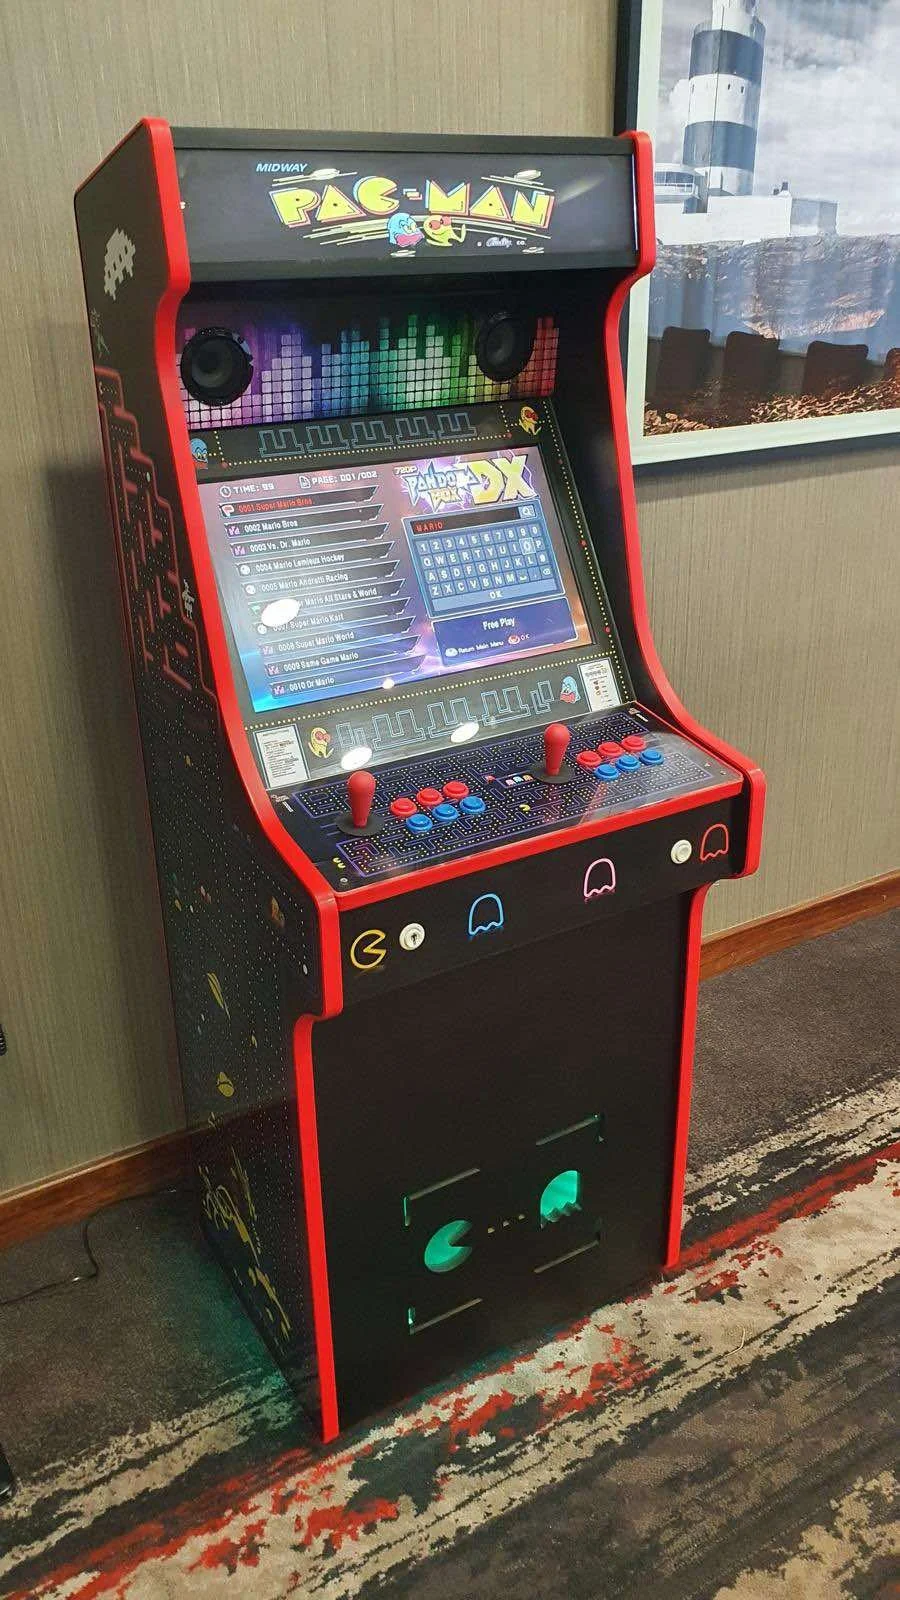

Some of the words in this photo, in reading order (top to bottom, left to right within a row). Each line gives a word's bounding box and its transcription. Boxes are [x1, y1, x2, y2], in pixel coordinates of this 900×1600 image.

[256, 163, 307, 173] MIDWAY
[269, 175, 555, 228] PAC-MAN
[233, 485, 259, 494] TIME:
[262, 483, 275, 491] 99
[312, 475, 338, 485] PAGE:
[469, 454, 534, 505] DX
[256, 501, 275, 511] Super
[276, 499, 296, 509] Mario
[244, 523, 261, 533] 0002
[262, 521, 281, 531] Mario
[282, 519, 298, 528] Bros
[415, 522, 443, 532] MARIO
[250, 543, 267, 553] 0003
[291, 538, 311, 547] Mario
[255, 562, 273, 572] 0004
[273, 560, 292, 570] Mario
[293, 557, 320, 568] Lemieux
[321, 554, 345, 565] Hockey
[261, 582, 278, 592] 0005
[279, 580, 298, 590] Mario
[325, 573, 349, 584] Racing
[304, 596, 324, 606] Mario
[325, 594, 334, 603] All
[334, 592, 352, 601] Stars
[352, 590, 358, 598] &
[358, 587, 377, 597] World
[489, 590, 502, 599] OK
[290, 619, 310, 630] Super
[310, 615, 329, 626] Mario
[330, 613, 344, 623] Kart
[483, 620, 499, 630] Free
[500, 617, 515, 627] Play
[295, 638, 315, 650] Super
[315, 635, 335, 646] Mario
[335, 631, 354, 642] World
[284, 661, 301, 672] 0009
[320, 655, 339, 666] Game
[340, 652, 359, 662] Mario
[289, 680, 305, 691] 0010
[306, 679, 314, 688] Dr
[315, 676, 335, 687] Mario
